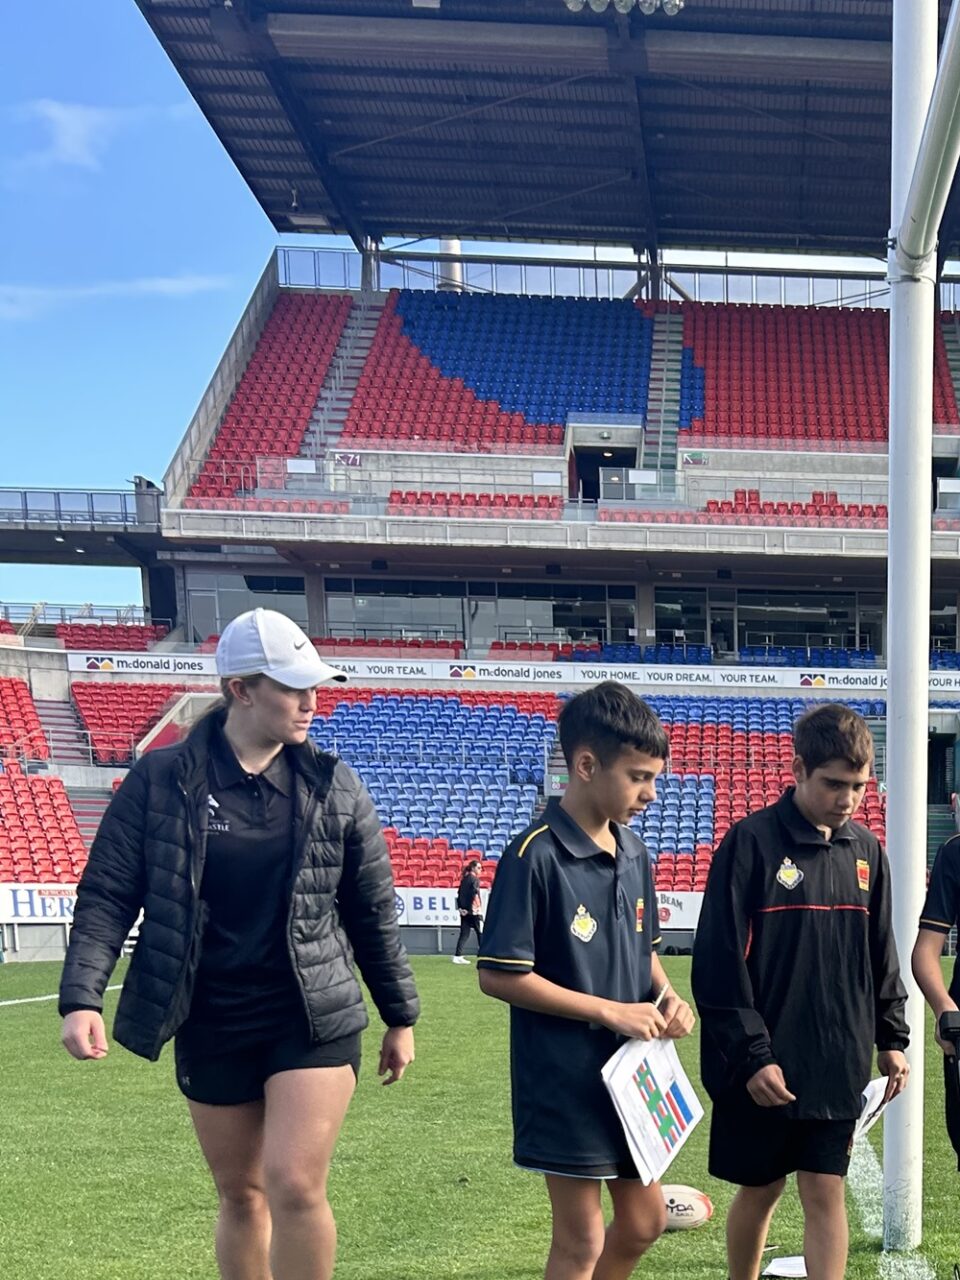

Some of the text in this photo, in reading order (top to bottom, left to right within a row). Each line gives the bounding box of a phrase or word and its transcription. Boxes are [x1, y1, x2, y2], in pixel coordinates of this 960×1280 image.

[347, 453, 360, 466] 71
[116, 657, 204, 672] mcdonald jones
[366, 665, 427, 676] YOUR TEAM.
[478, 666, 562, 680] mcdonald jones
[580, 670, 640, 681] YOUR HOME.
[647, 671, 712, 683] YOUR DREAM.
[720, 673, 778, 684] YOUR TEAM.
[828, 674, 878, 686] mcdonald
[928, 678, 952, 687] YOUR
[9, 888, 74, 918] HER
[413, 896, 459, 911] BEL
